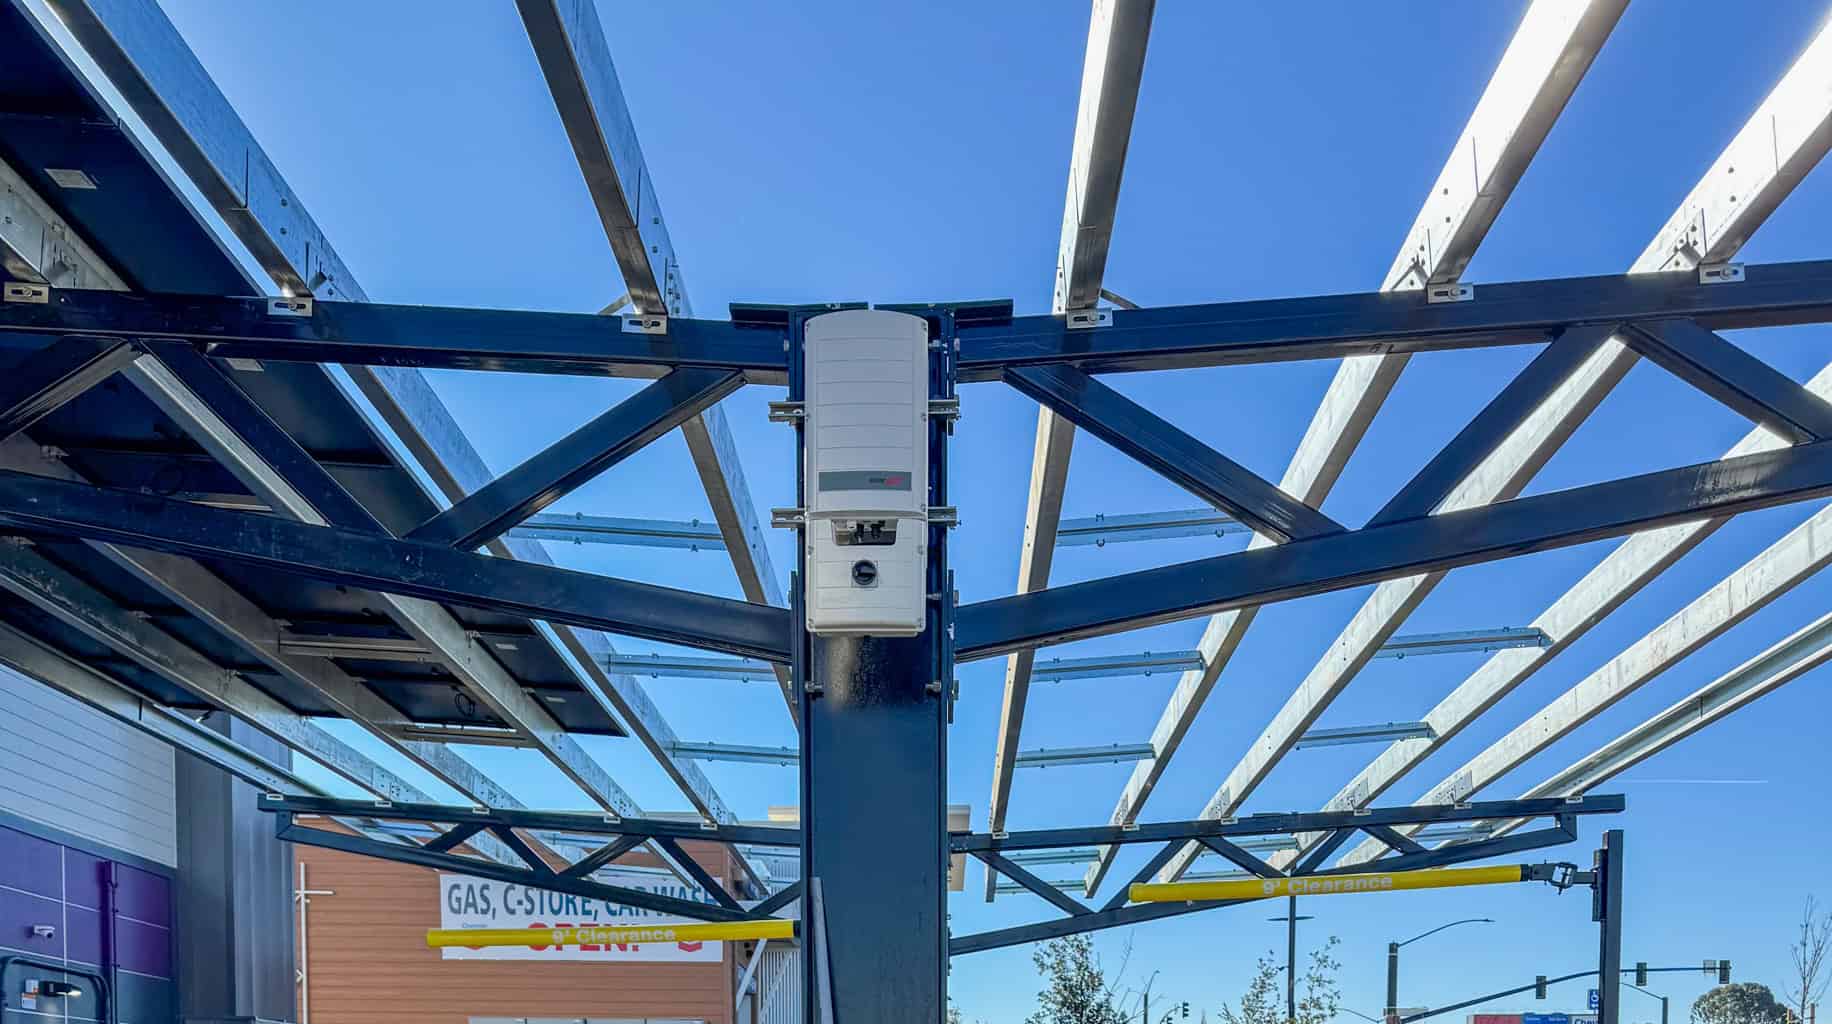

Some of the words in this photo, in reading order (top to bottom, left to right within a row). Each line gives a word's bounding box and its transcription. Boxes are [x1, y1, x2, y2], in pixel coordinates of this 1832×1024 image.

[1288, 877, 1392, 895] Clearance
[448, 883, 496, 921] GAS,
[504, 884, 598, 922] C-STORE,
[576, 928, 676, 944] Clearance
